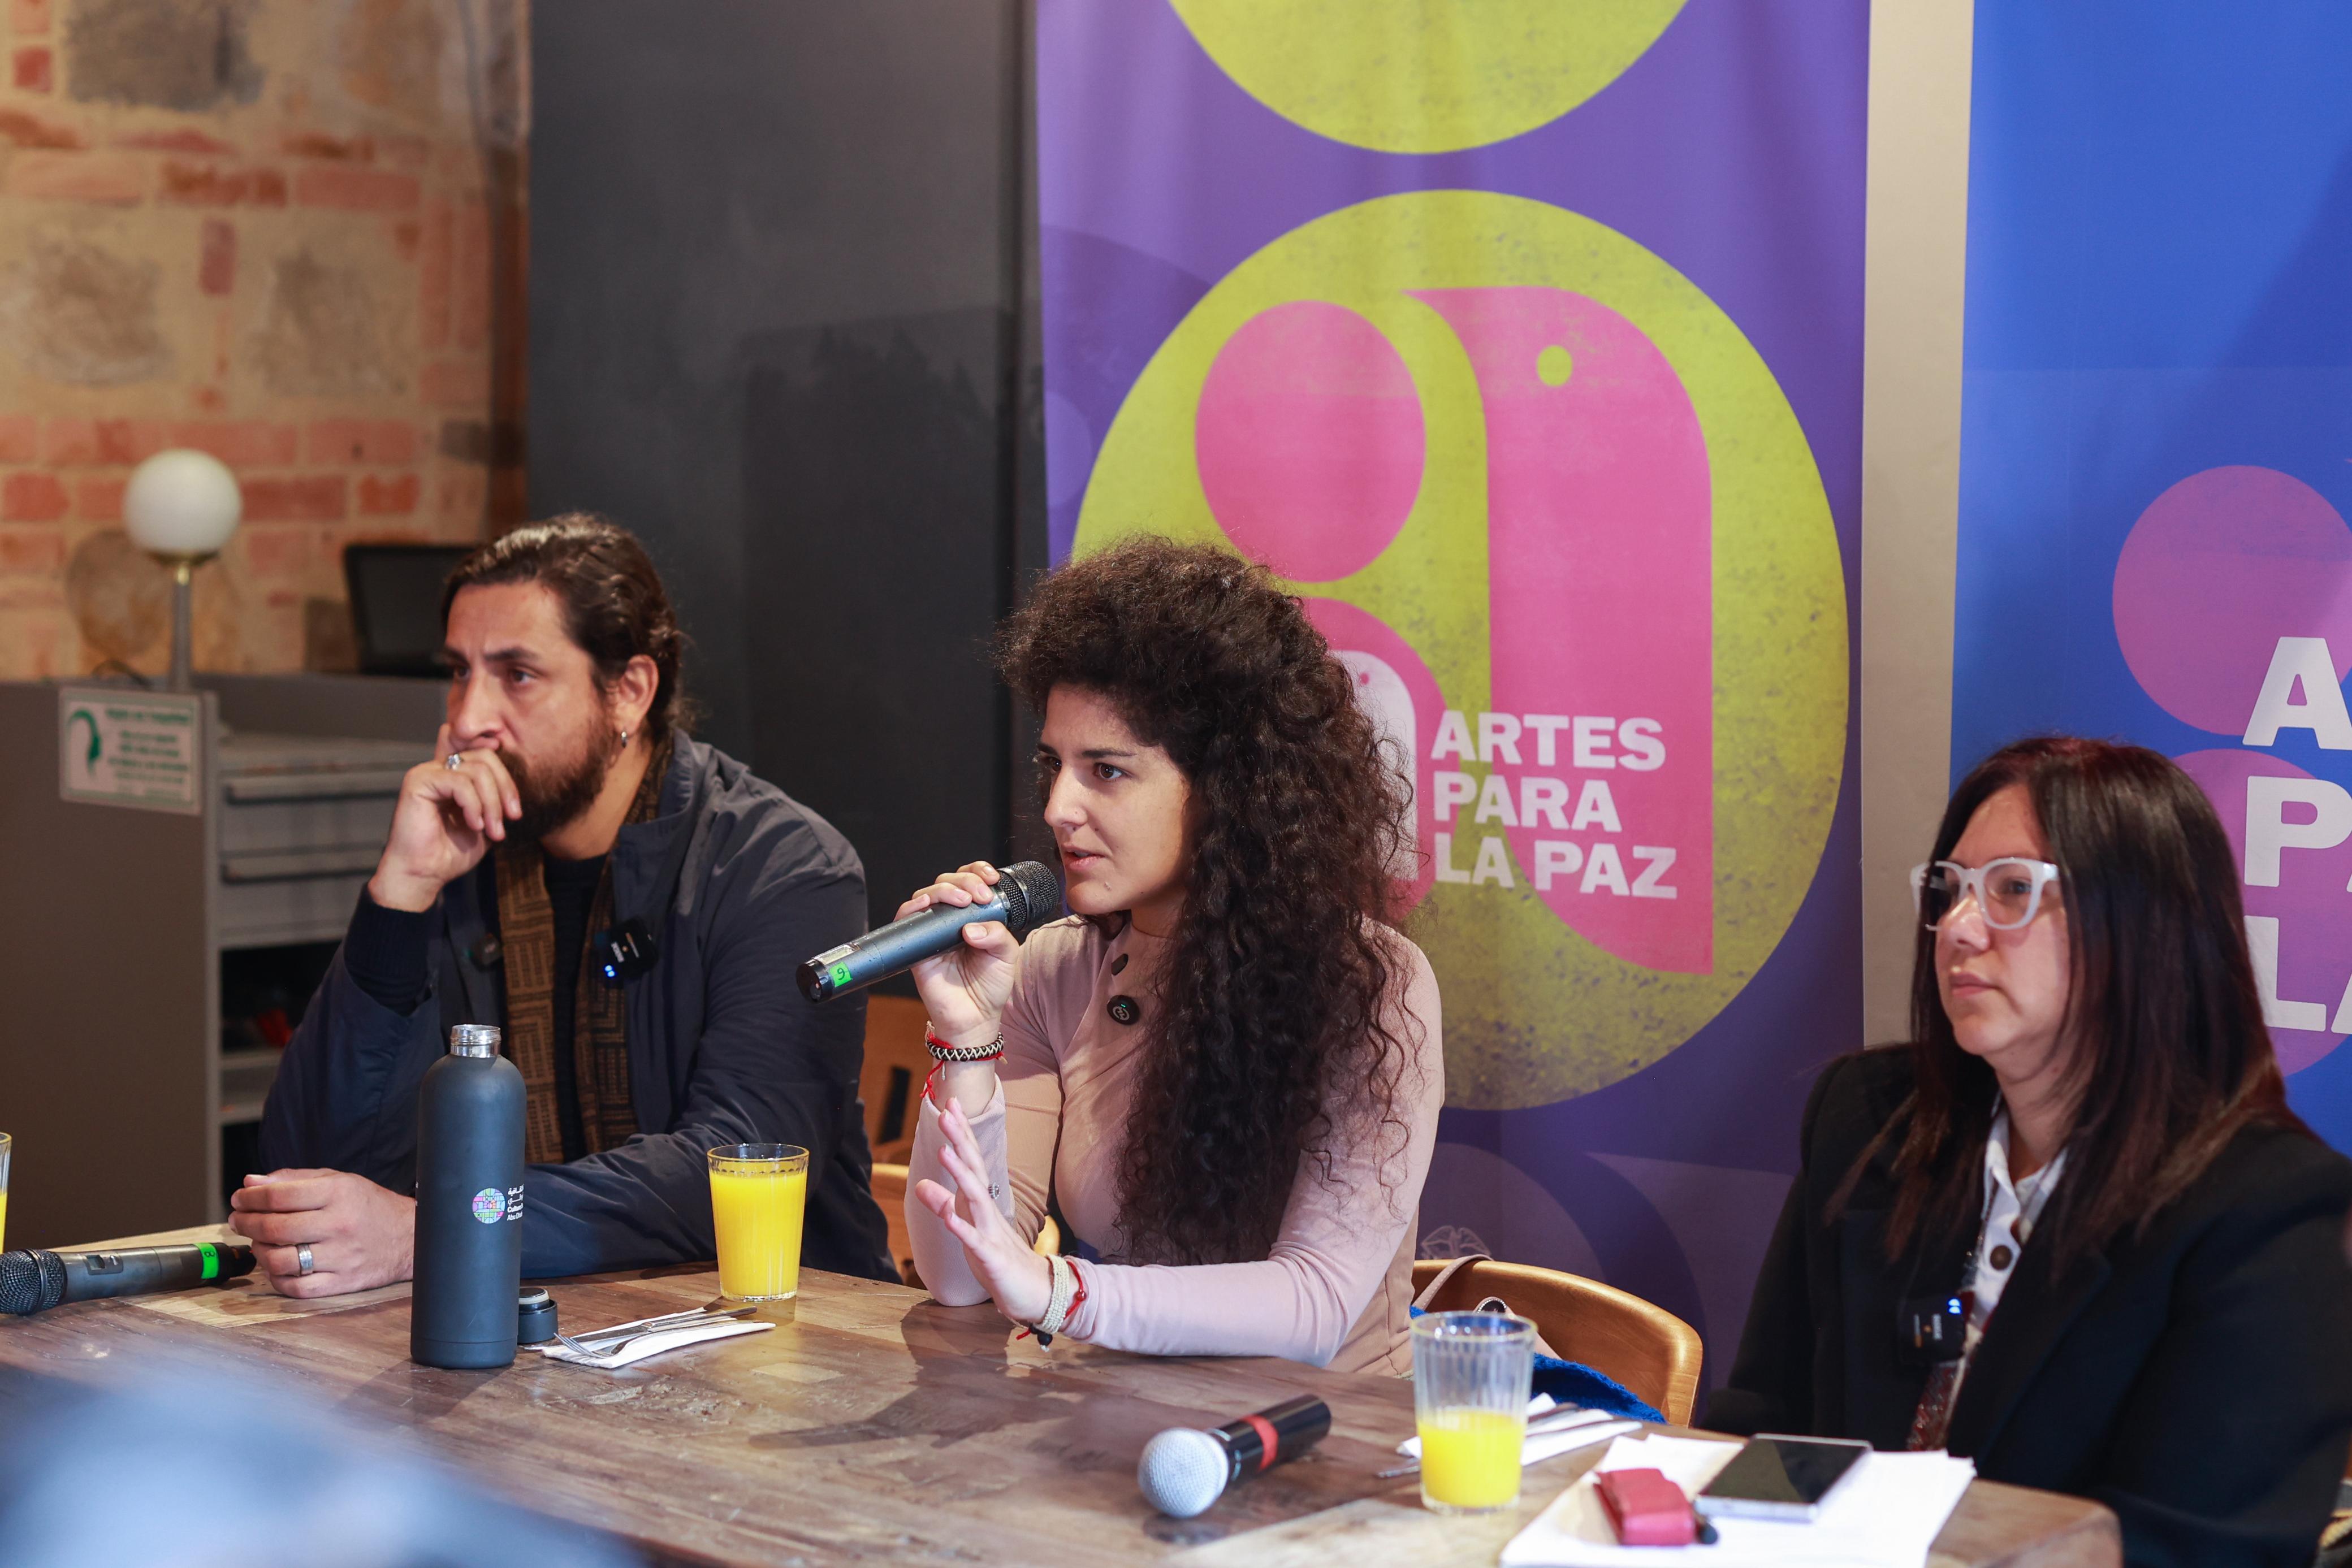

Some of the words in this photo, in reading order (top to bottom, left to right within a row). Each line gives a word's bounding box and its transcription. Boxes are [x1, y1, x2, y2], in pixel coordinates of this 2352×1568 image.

[1431, 710, 1666, 770] ARTES
[1433, 771, 1622, 832] PARA
[2244, 775, 2352, 893] P
[1434, 832, 1515, 889] LA
[1533, 840, 1677, 899] PAZ
[2243, 915, 2352, 1034] L
